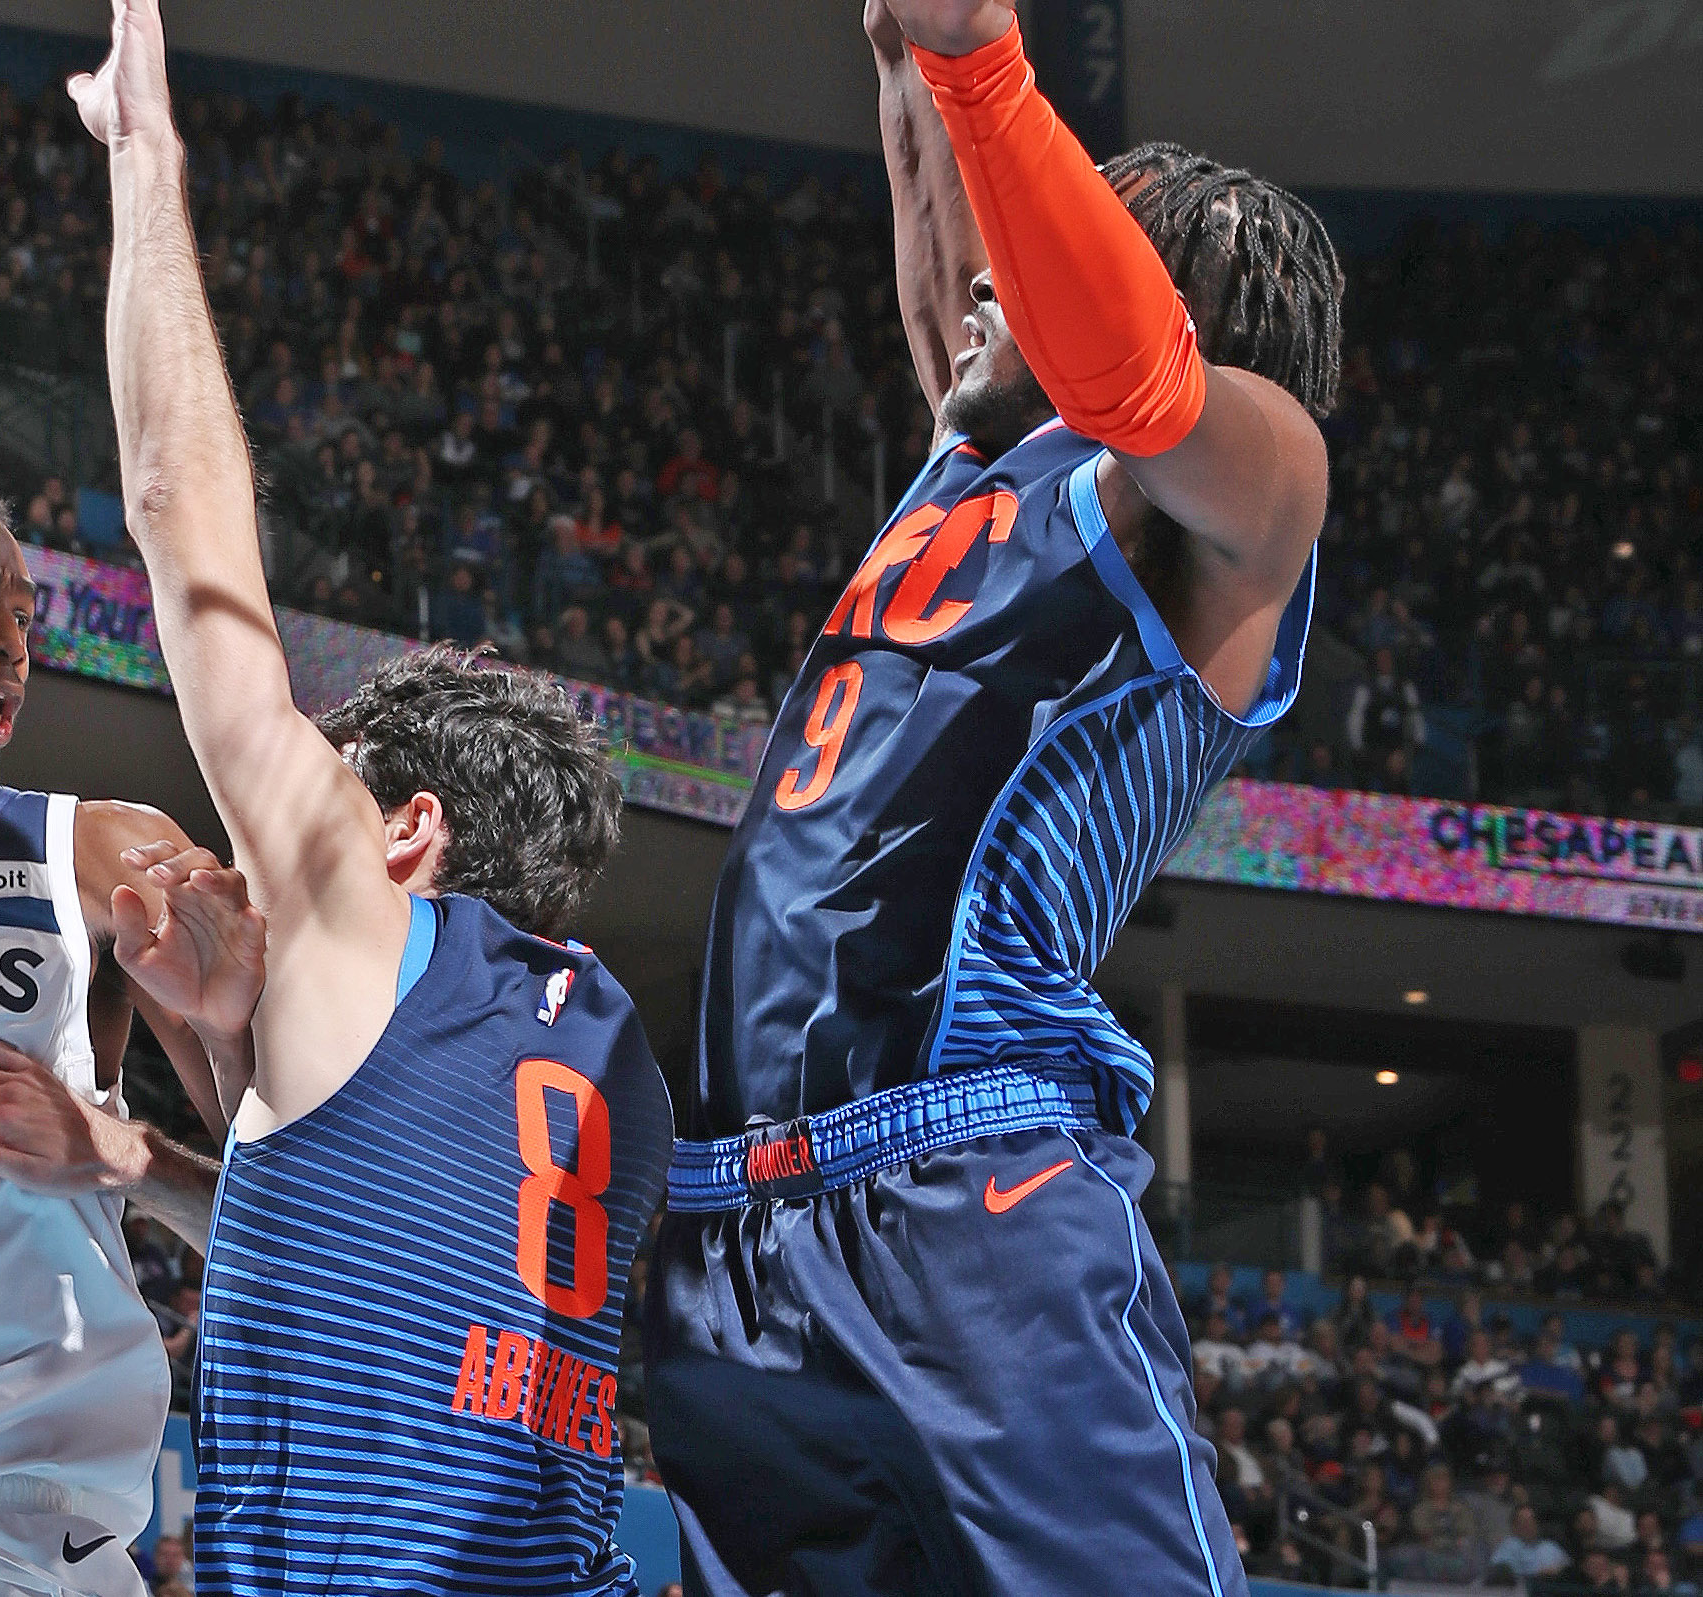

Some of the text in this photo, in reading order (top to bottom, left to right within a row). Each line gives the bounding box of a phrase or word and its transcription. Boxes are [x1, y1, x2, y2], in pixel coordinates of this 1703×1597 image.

[775, 660, 864, 811] 9
[1430, 807, 1702, 874] CHESAPEA
[514, 1058, 611, 1320] 8
[451, 1324, 618, 1459] ABRINES
